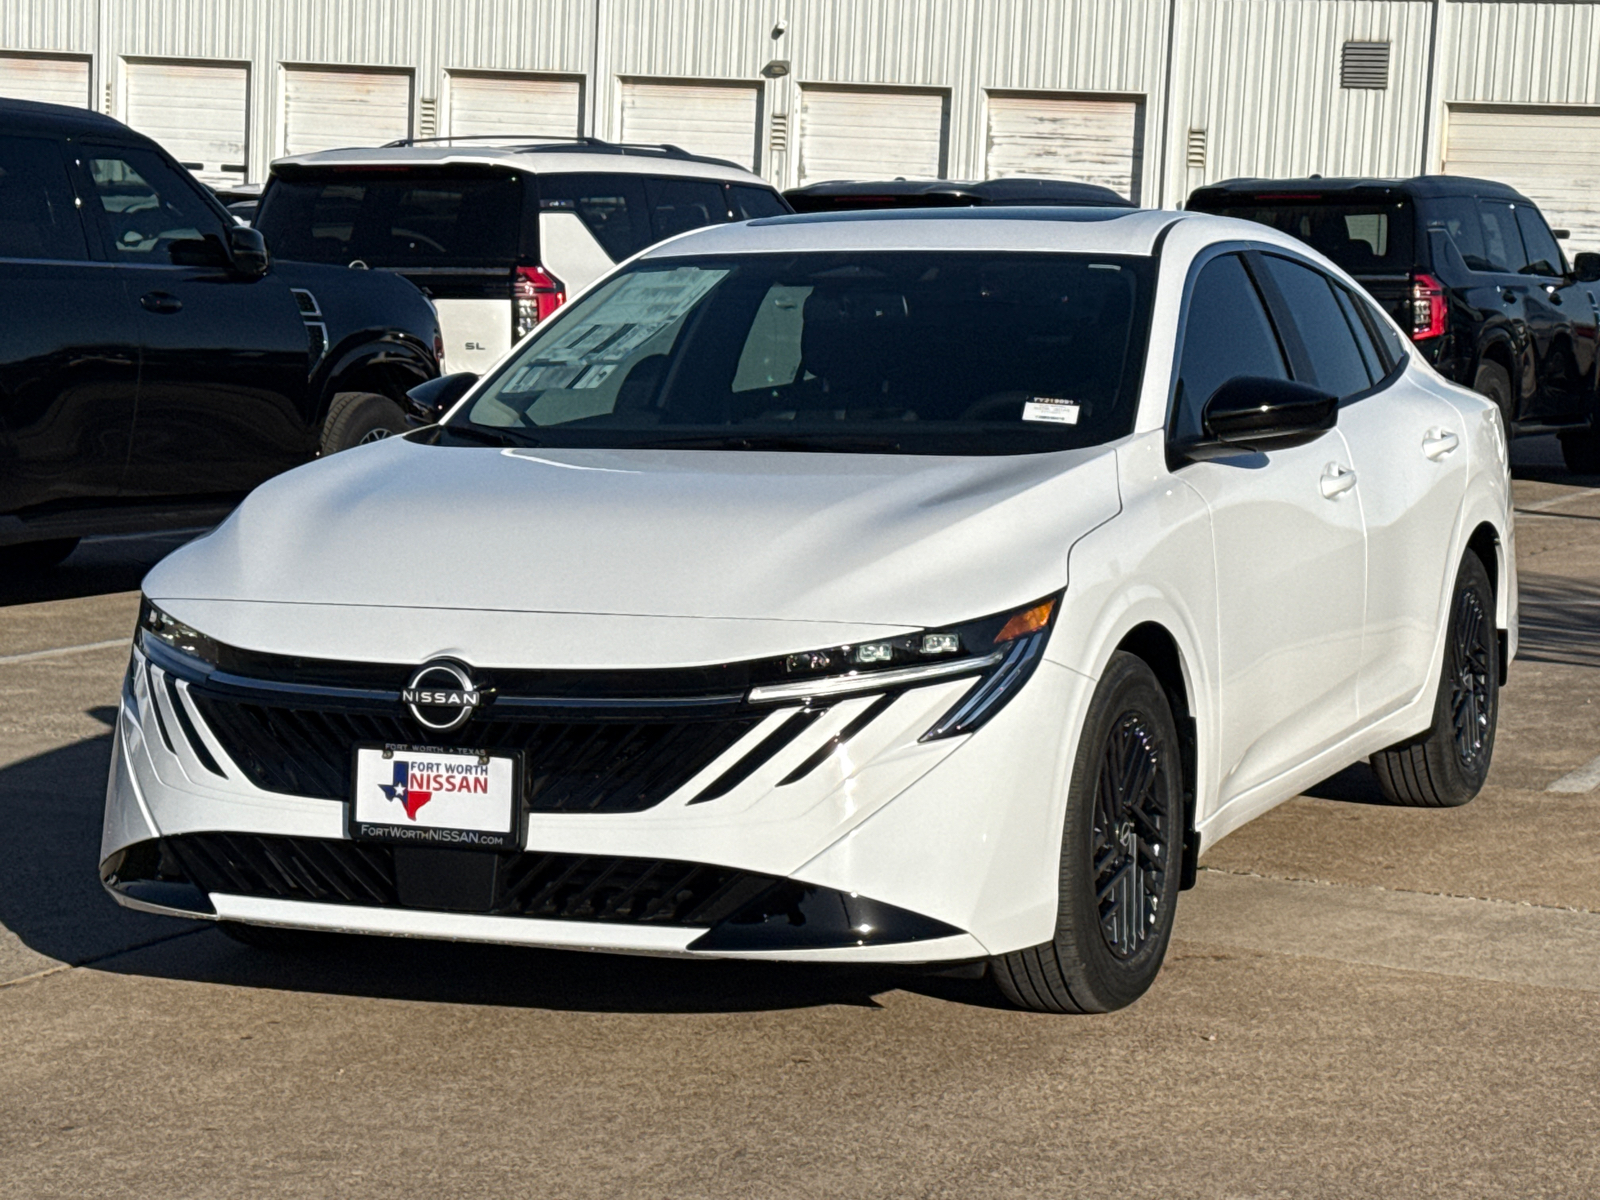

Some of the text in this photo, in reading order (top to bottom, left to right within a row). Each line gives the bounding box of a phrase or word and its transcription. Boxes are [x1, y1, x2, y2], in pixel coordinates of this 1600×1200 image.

[465, 342, 486, 350] SL
[402, 689, 477, 705] NISSAN
[385, 743, 486, 756] FORT WORTH TEXAS
[410, 761, 488, 776] FORT WORTH
[409, 773, 488, 794] NISSAN
